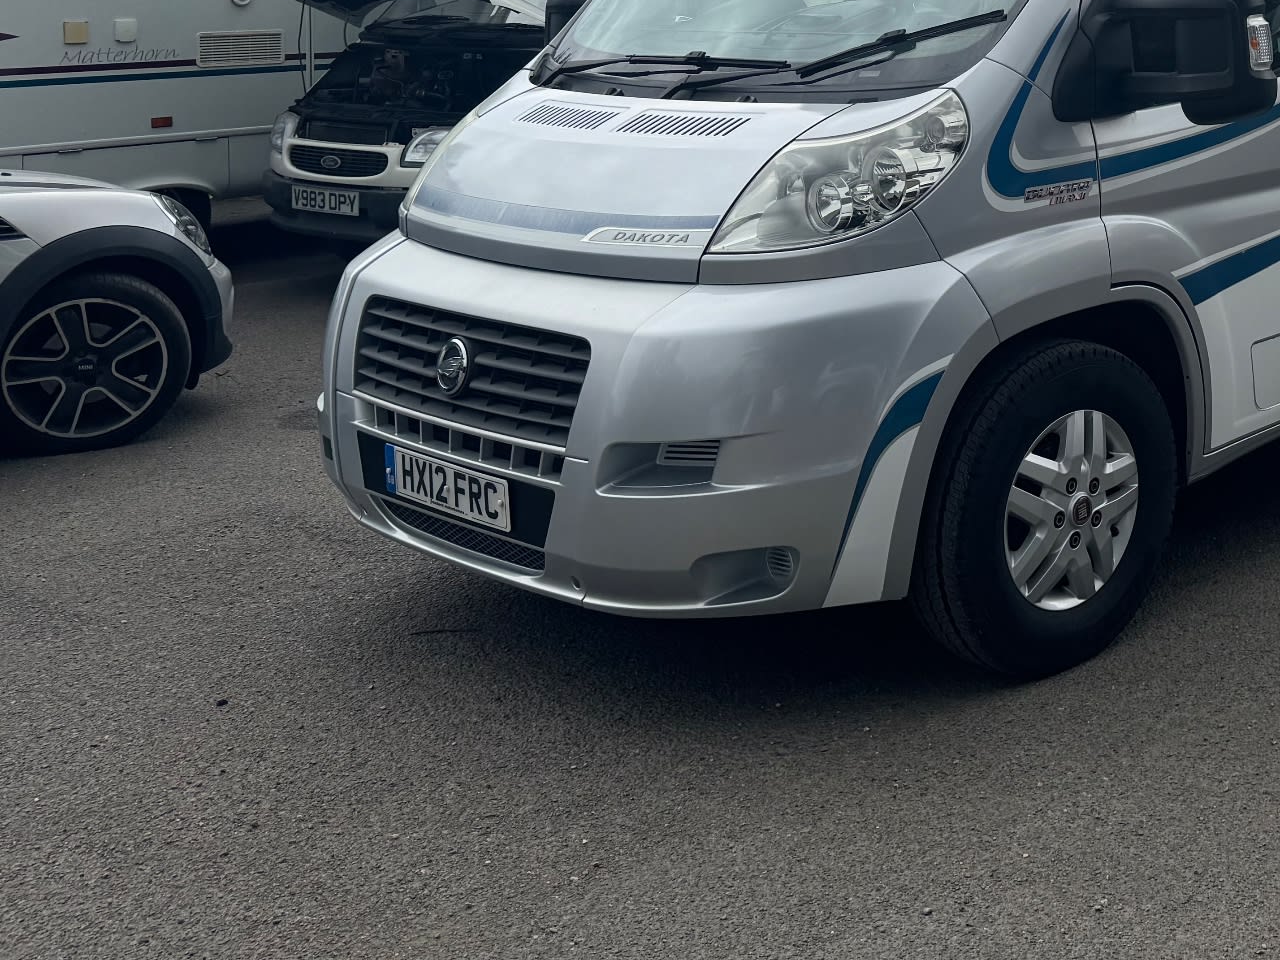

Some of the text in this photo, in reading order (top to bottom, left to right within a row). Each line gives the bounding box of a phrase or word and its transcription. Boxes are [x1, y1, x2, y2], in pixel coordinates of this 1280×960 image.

[60, 42, 180, 64] Matterhorn
[294, 188, 356, 213] V983 DPY
[613, 231, 690, 244] DAKOTA
[401, 453, 499, 520] HX12 FRC
